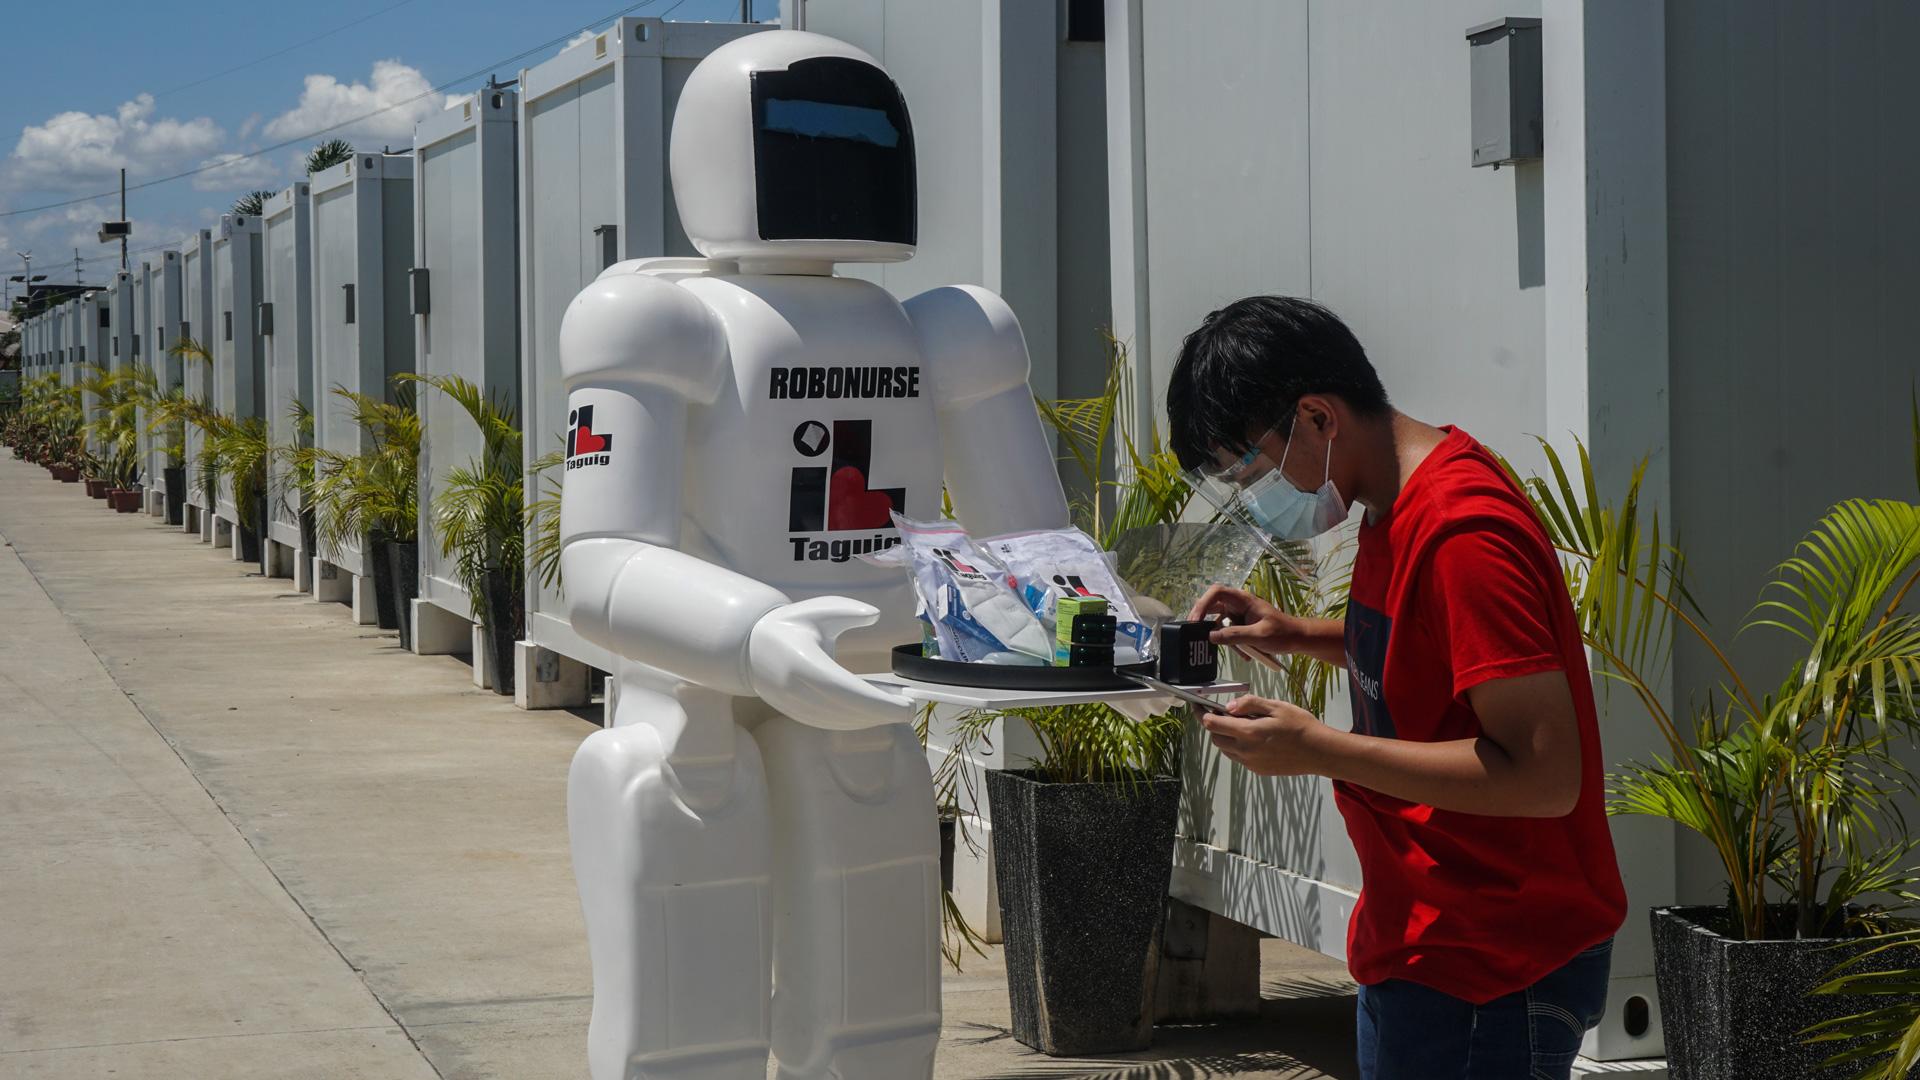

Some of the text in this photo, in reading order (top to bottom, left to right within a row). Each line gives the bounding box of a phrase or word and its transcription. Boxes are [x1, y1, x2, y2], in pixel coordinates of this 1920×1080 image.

[769, 366, 920, 400] ROBONURSE
[566, 454, 610, 471] Taguig
[1189, 640, 1213, 667] JBL
